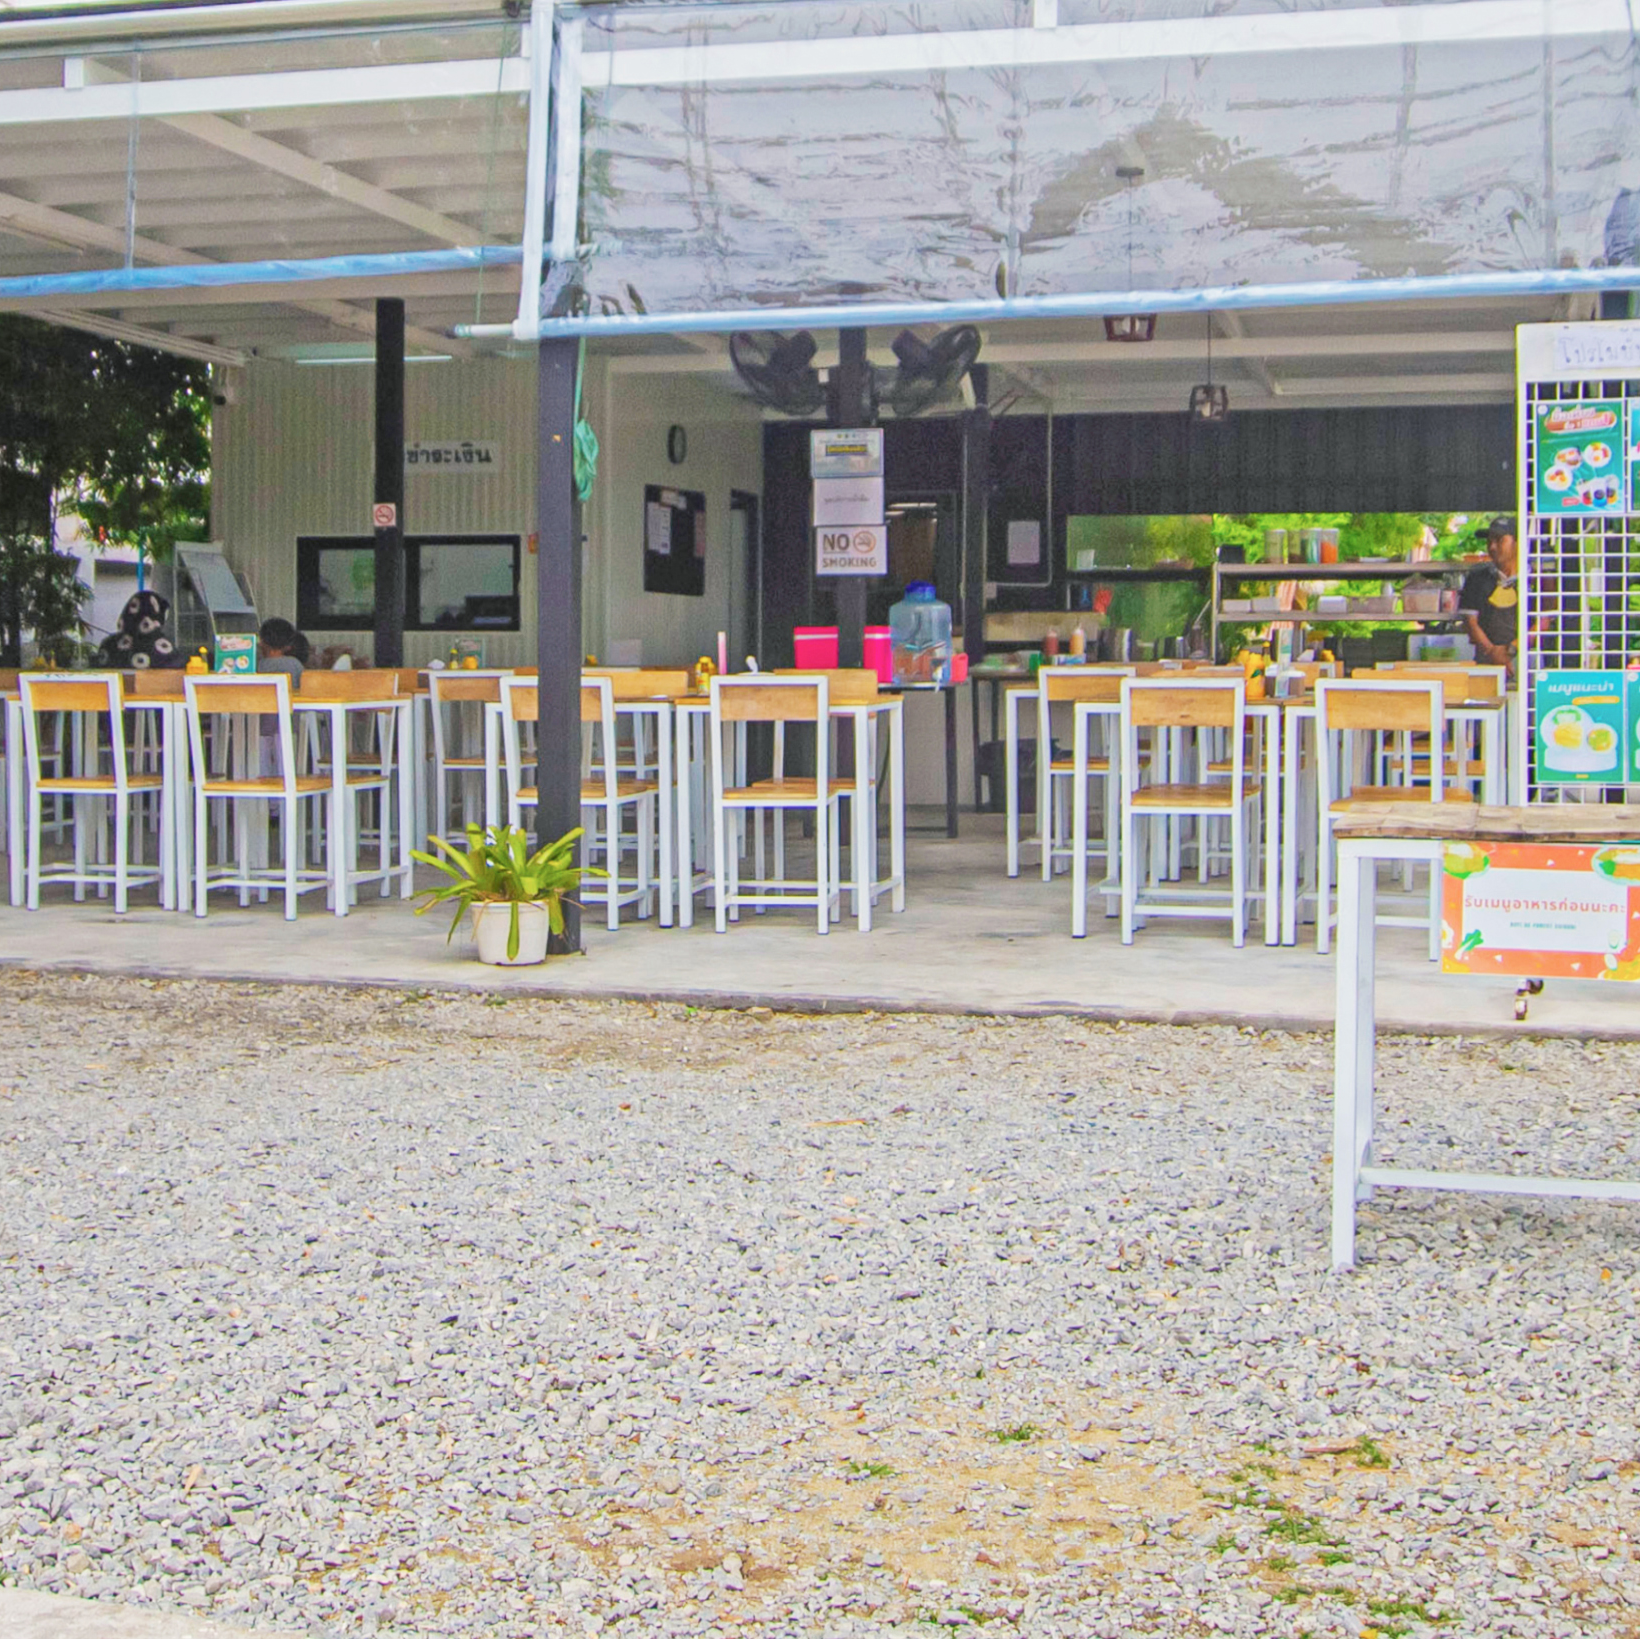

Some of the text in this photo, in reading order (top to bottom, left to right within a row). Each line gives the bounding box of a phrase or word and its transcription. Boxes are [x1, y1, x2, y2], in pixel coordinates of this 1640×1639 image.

[823, 534, 849, 550] NO
[822, 557, 877, 568] SMOKING
[1465, 895, 1626, 913] รับเมนูอาหารก่อนนะคะ
